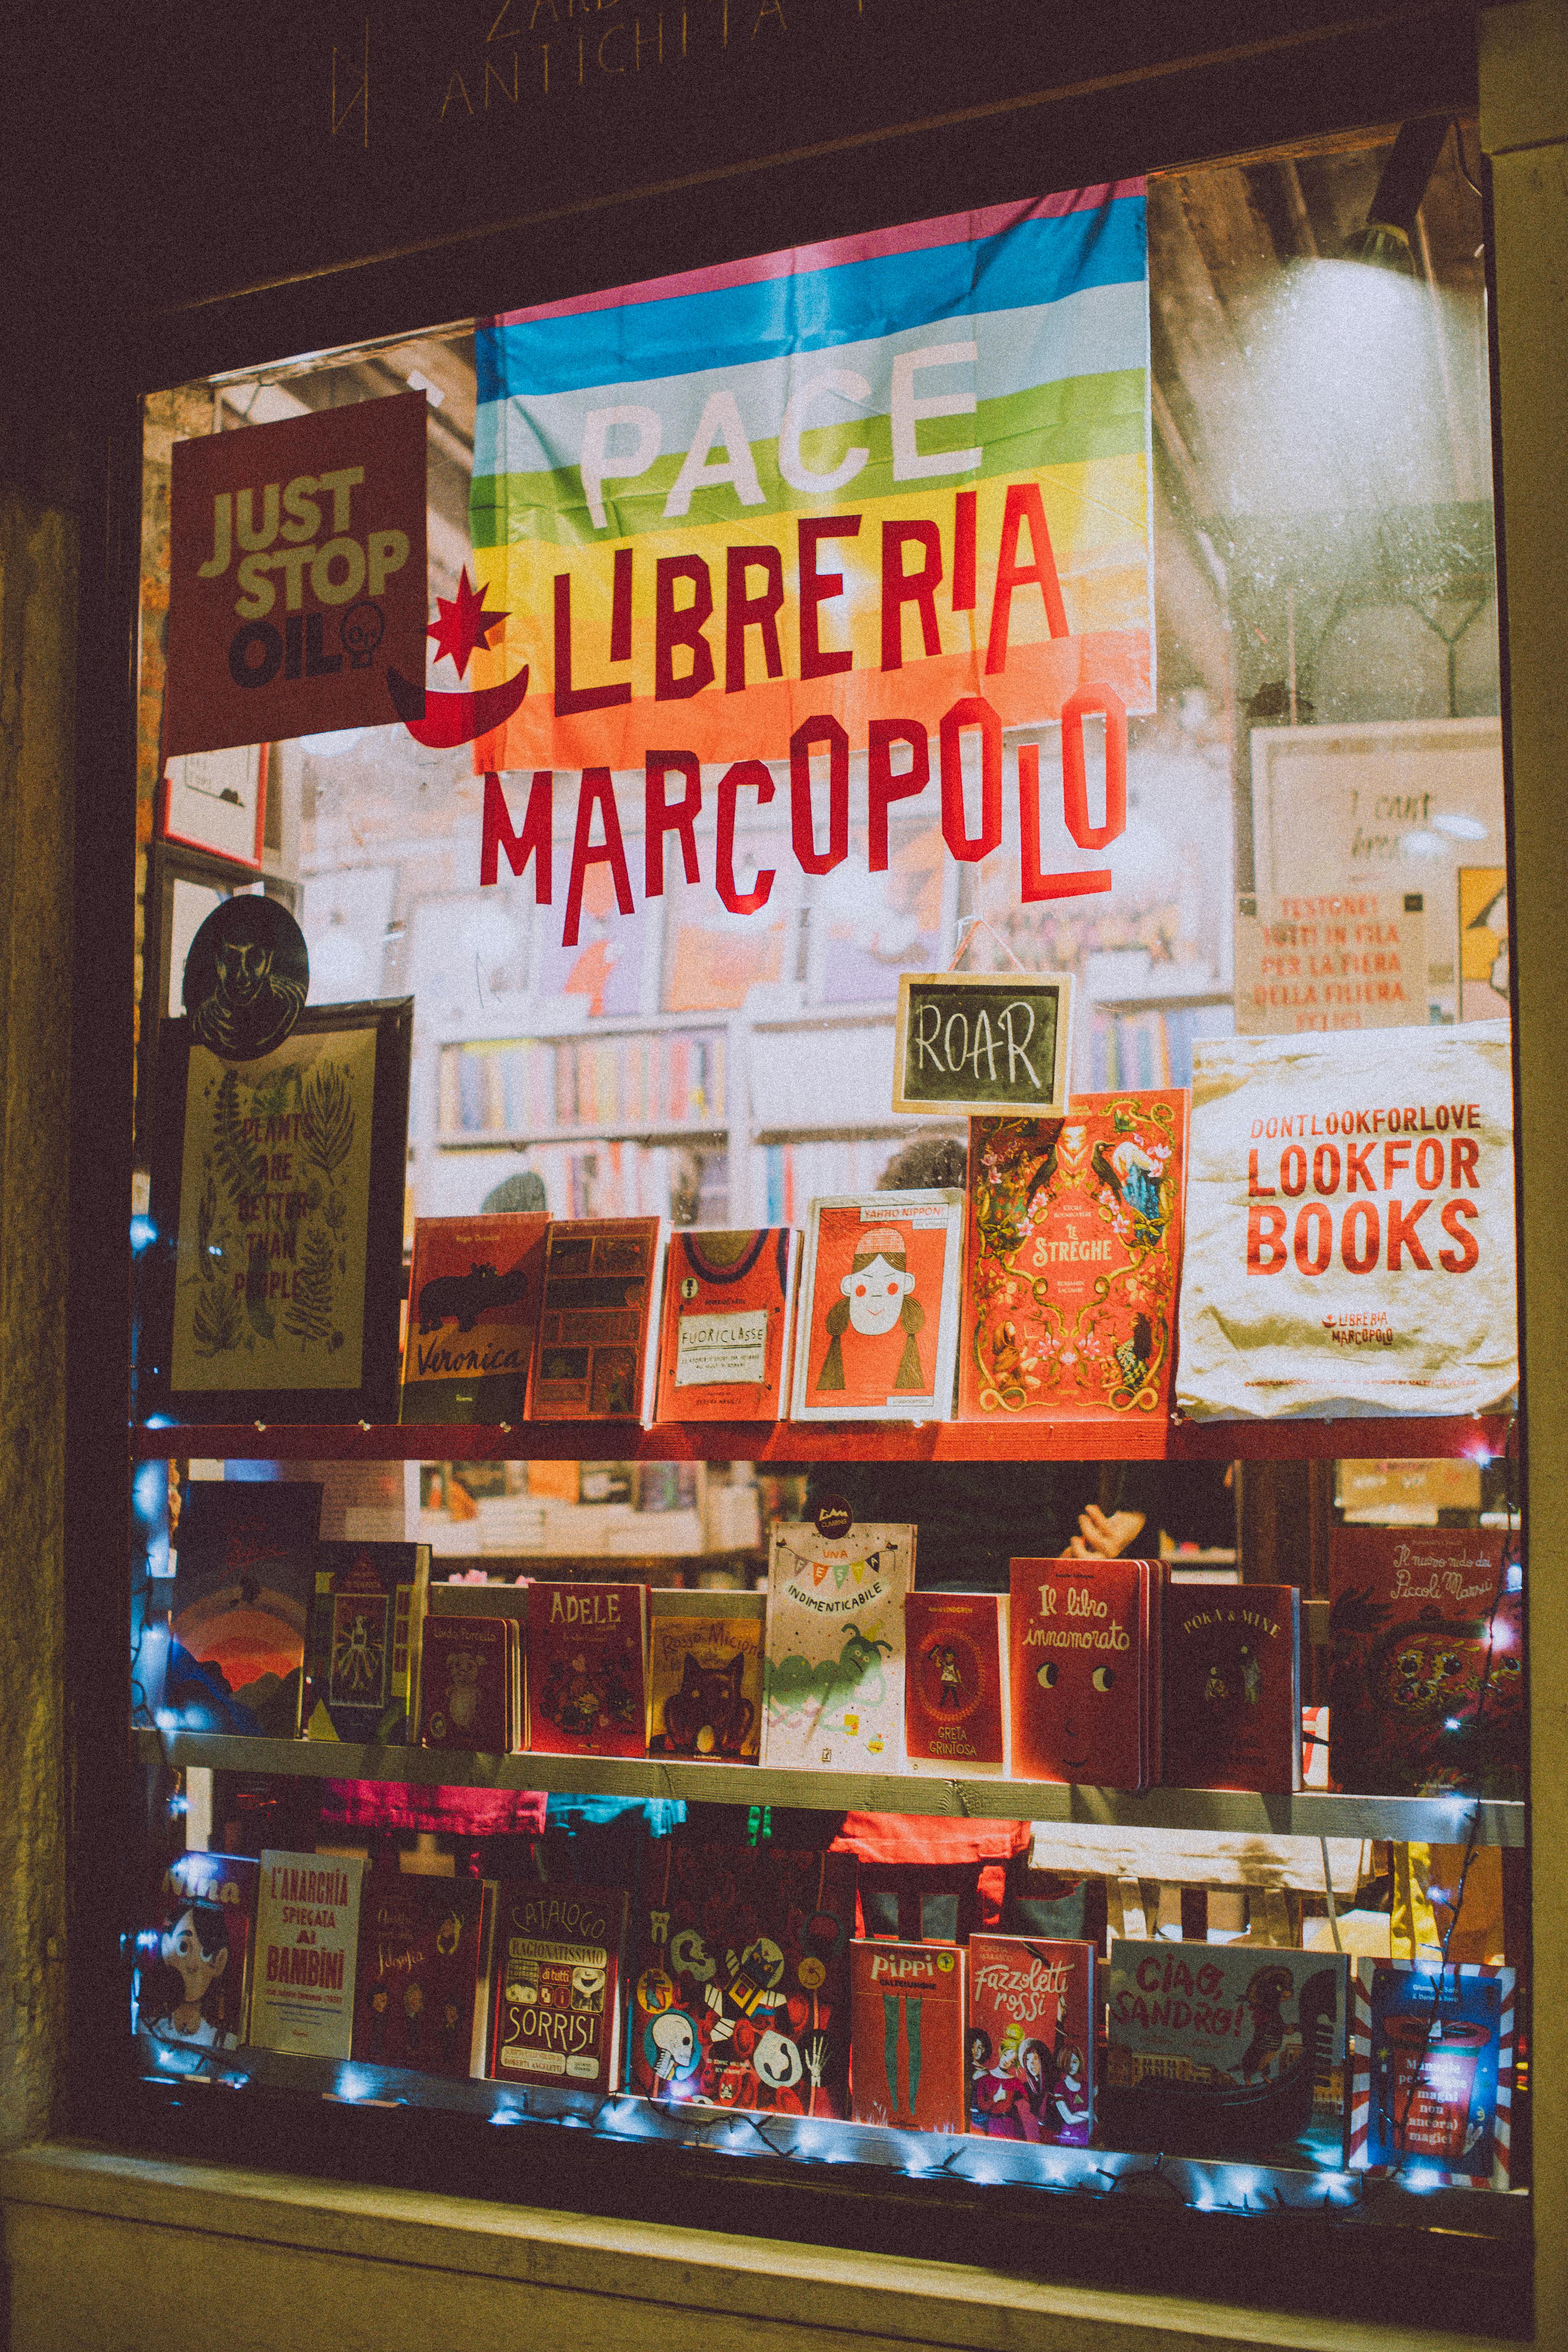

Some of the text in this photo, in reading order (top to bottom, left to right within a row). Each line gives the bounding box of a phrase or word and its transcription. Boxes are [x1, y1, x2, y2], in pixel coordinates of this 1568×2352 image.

[581, 339, 982, 529] PACE
[197, 466, 365, 577] JUST
[234, 530, 410, 620] STOP
[554, 482, 1069, 718] LIBRERIA
[229, 612, 342, 688] OIL
[480, 682, 1127, 947] MARCOPOLO
[916, 1002, 1041, 1089] ROAR
[243, 1113, 314, 1143] PLANTS
[1250, 1104, 1481, 1139] DONTLOOKFORLOVE
[257, 1153, 293, 1181] ARE
[1248, 1138, 1480, 1197] LOOKFOR
[238, 1191, 307, 1221] BETTER
[864, 1208, 900, 1218] YAHHO
[246, 1232, 296, 1259] THAN
[1065, 1224, 1079, 1241] LE
[1246, 1198, 1480, 1276] BOOKS
[1033, 1238, 1112, 1267] STREGHE
[1338, 1312, 1388, 1327] LIBRERIA
[682, 1326, 764, 1344] FUORICLASSE
[1332, 1327, 1394, 1347] MARCOPOLO
[417, 1337, 521, 1375] Veronica
[795, 1556, 879, 1582] FESTA
[823, 1550, 849, 1559] UNA
[549, 1592, 621, 1626] ADELE
[788, 1582, 883, 1612] INDIMENTICABILE
[1038, 1584, 1108, 1618] Il libro
[1022, 1619, 1130, 1650] innamorato
[937, 1726, 967, 1741] GRETA
[929, 1741, 977, 1757] GRINTOSA
[282, 1906, 336, 1929] SPIEGATA
[512, 1900, 605, 1939] CATALOGO
[512, 1940, 604, 1965] RAGIONATISSIMO
[878, 1978, 937, 1991] CALZELUNGHE
[975, 1959, 1074, 2002] Fazzoletti
[994, 1991, 1046, 2022] rossi
[1109, 1990, 1244, 2037] SANDRO!
[504, 2007, 595, 2053] SORRISI
[1419, 2105, 1444, 2114] non
[1409, 2131, 1453, 2146] magici
